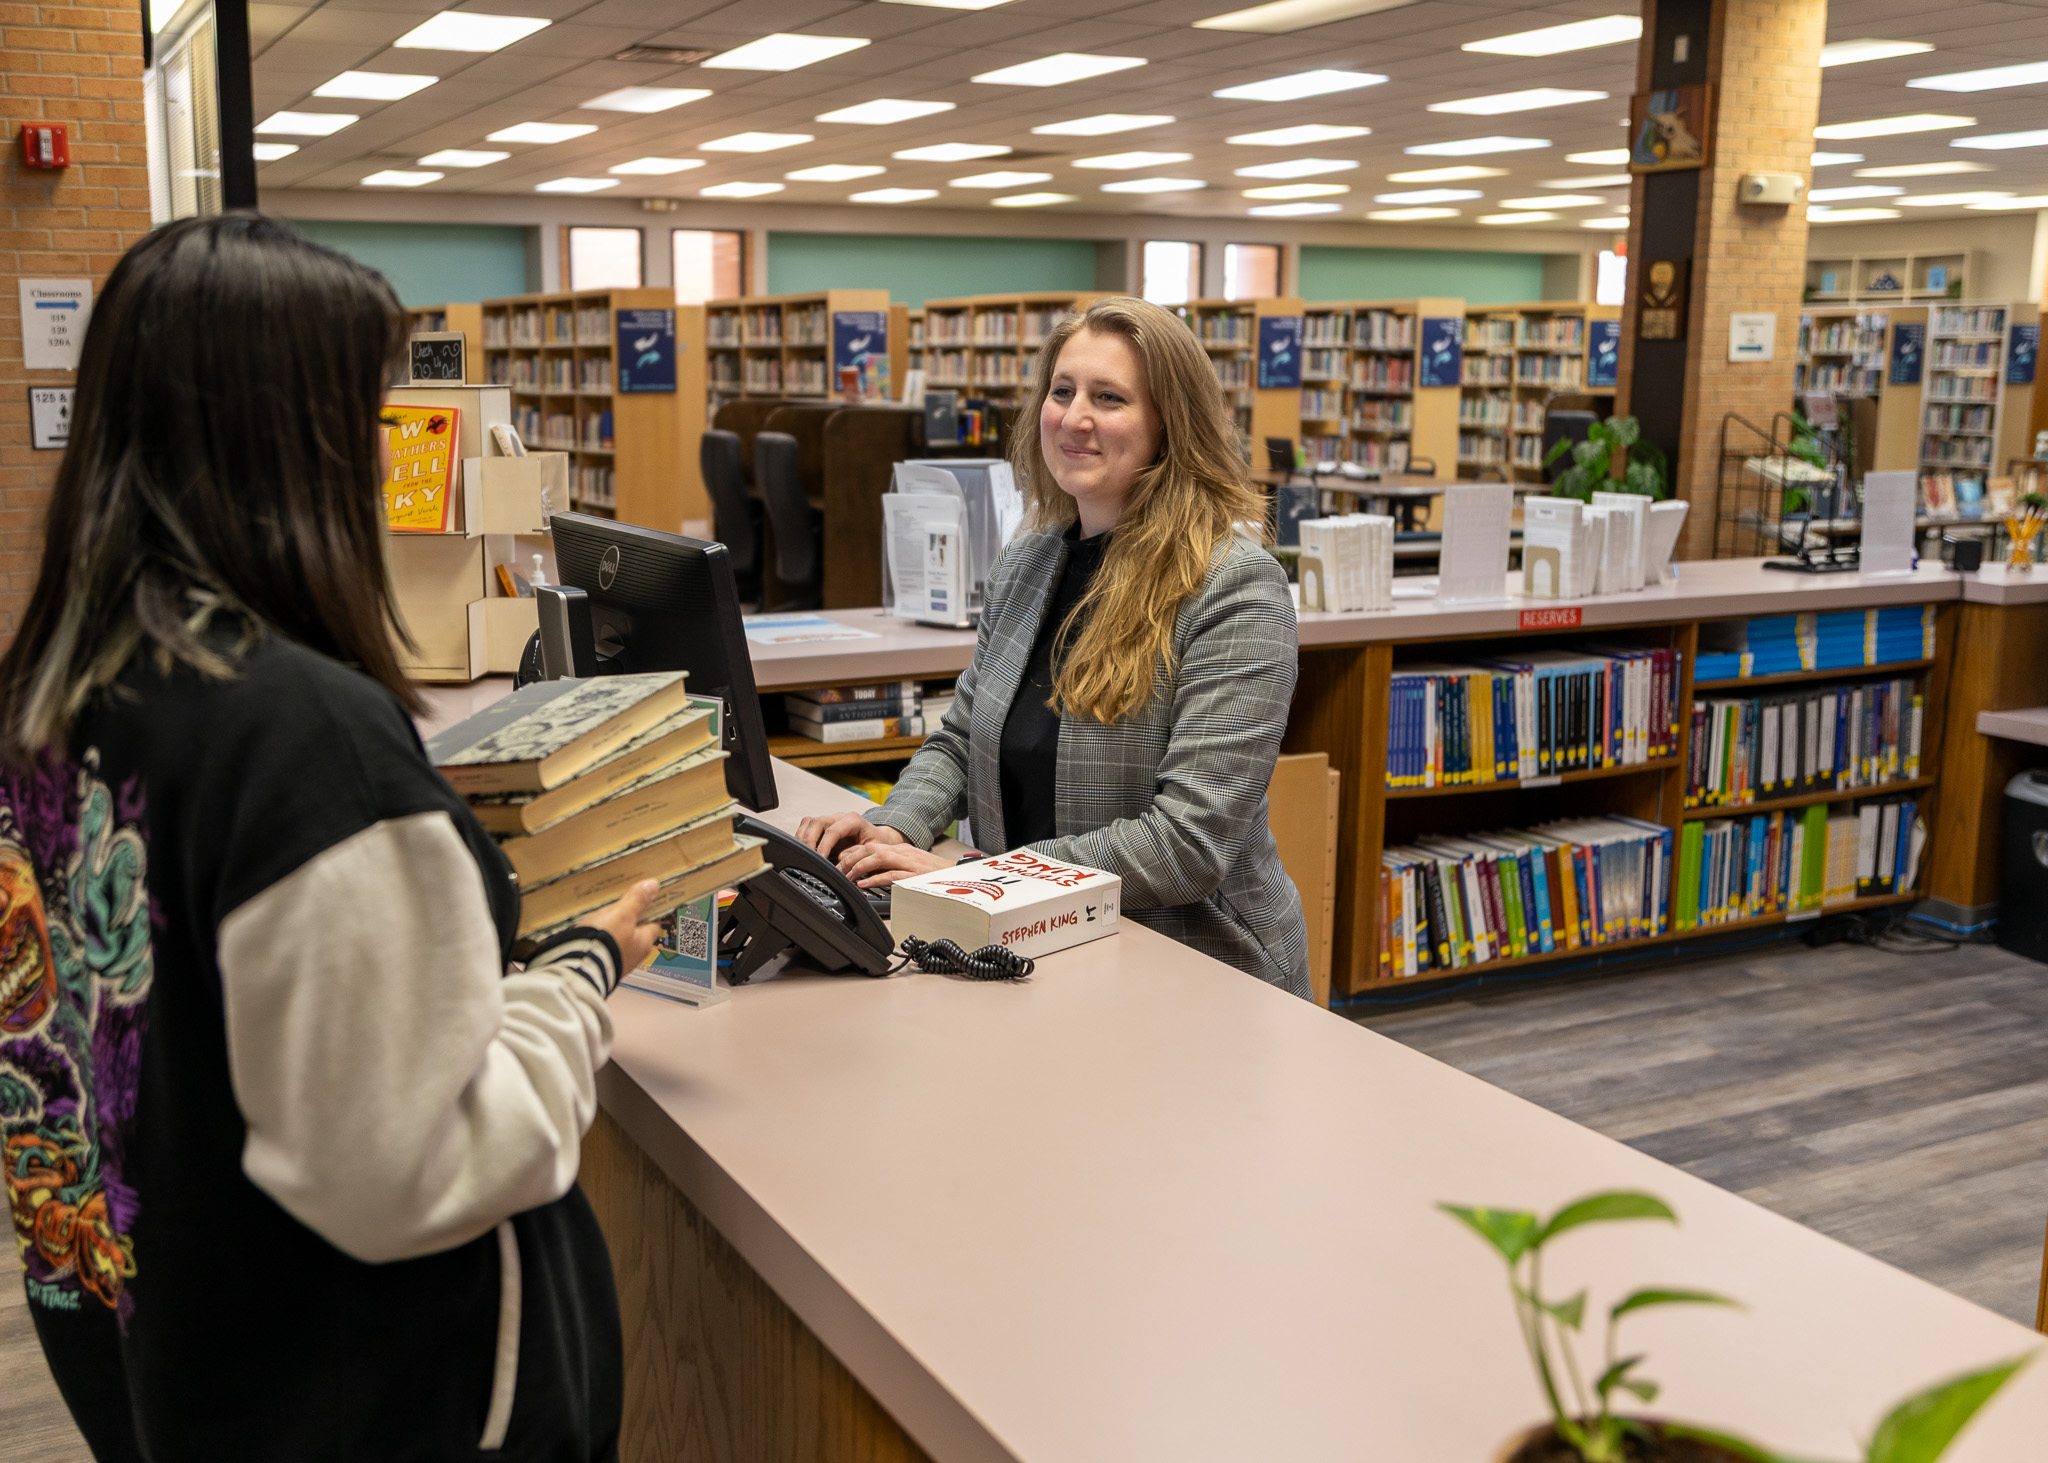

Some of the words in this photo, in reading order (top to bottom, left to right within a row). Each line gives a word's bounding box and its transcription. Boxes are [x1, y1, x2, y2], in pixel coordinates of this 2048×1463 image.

[31, 289, 82, 298] Classrooms
[391, 439, 447, 460] ATHERS
[392, 457, 446, 482] ELL
[601, 560, 616, 574] DELL
[1523, 608, 1577, 626] RESERVES
[854, 688, 876, 700] TODAY
[840, 709, 888, 720] ANTIQUITY
[983, 860, 1080, 887] STEPHEN
[1004, 853, 1097, 880] KING
[980, 875, 1022, 885] IT
[1086, 905, 1097, 922] IT
[1001, 919, 1046, 945] STEPHEN
[1050, 910, 1078, 931] KING
